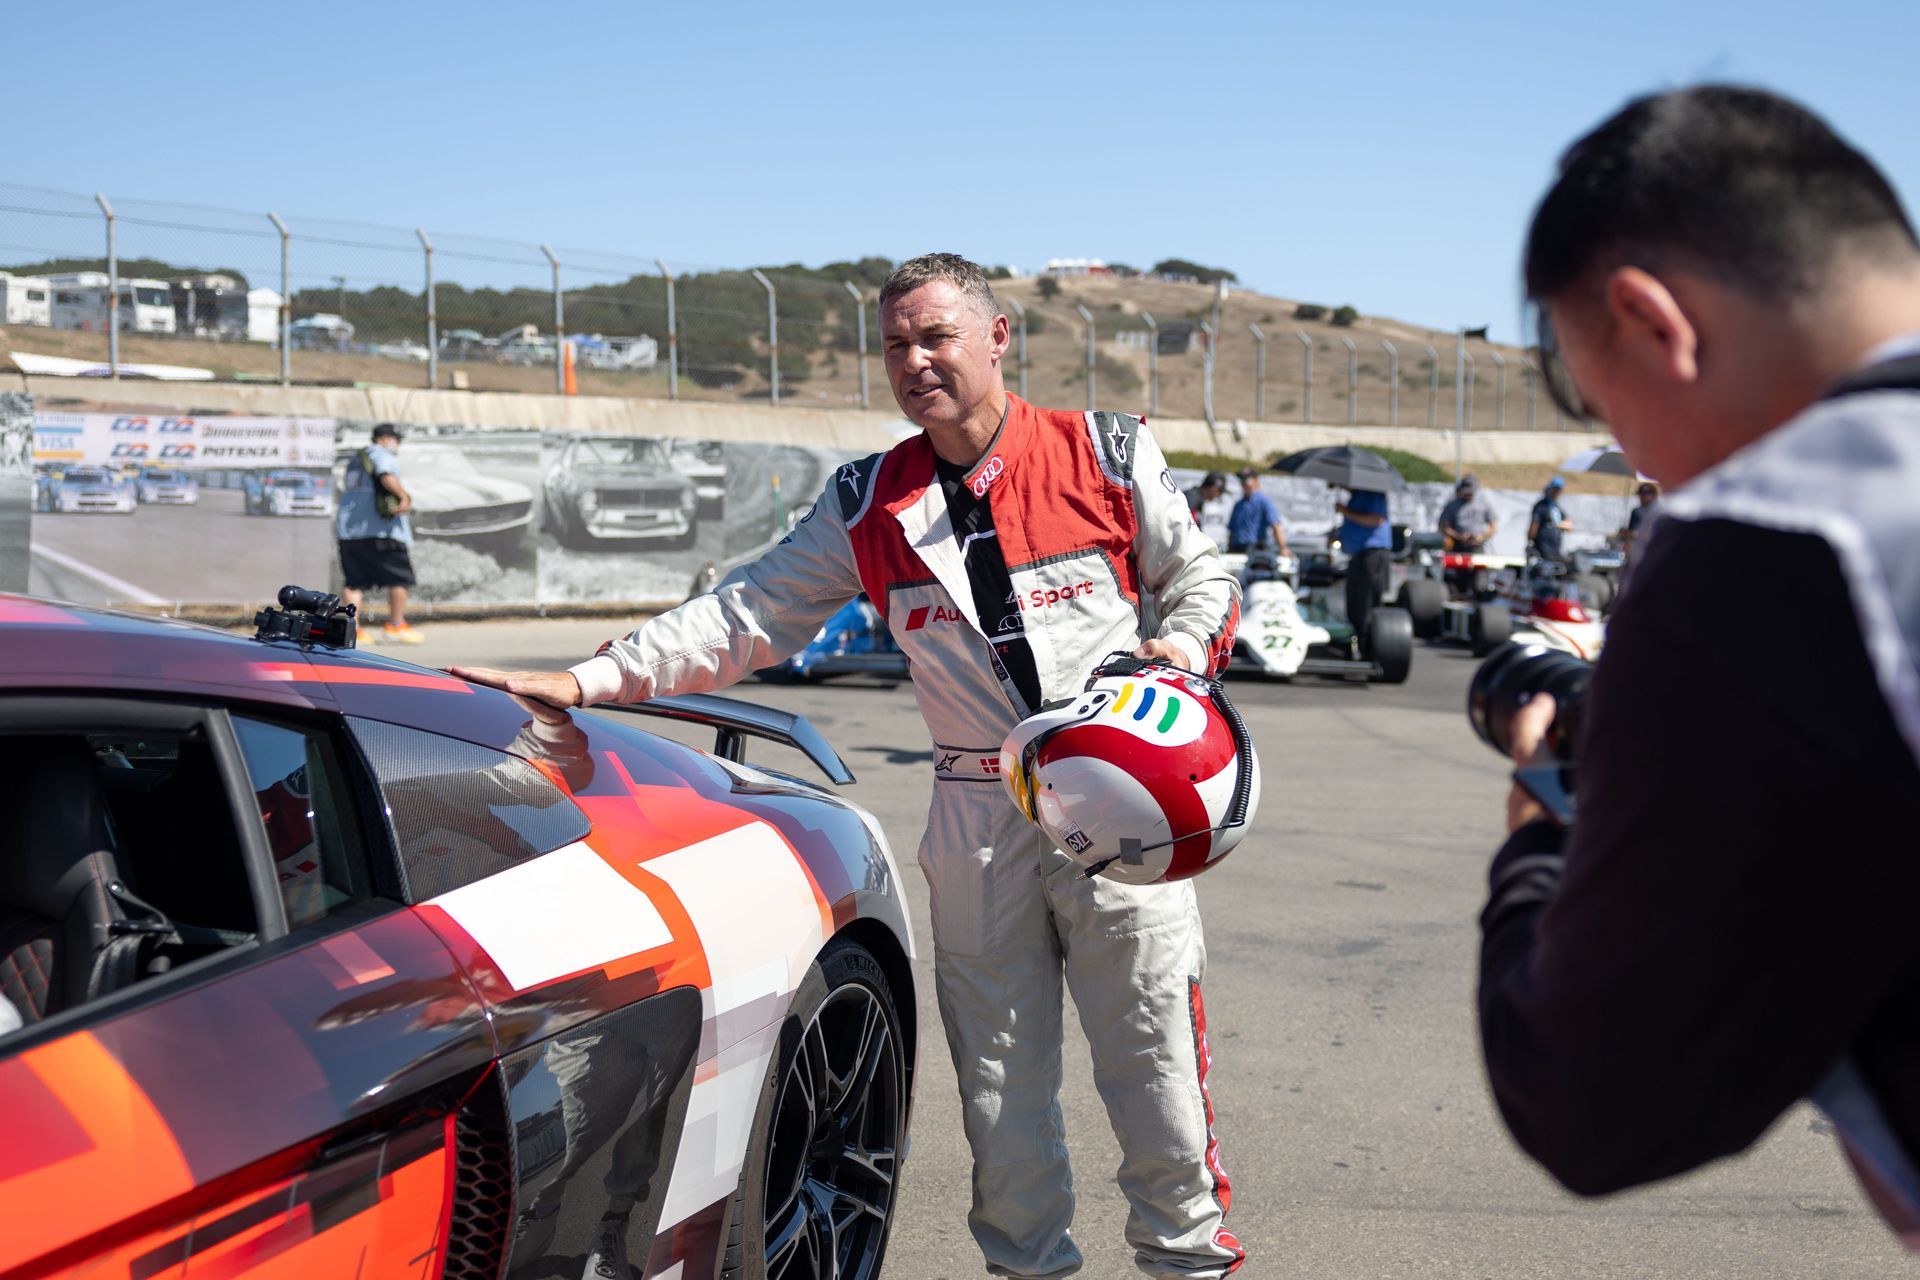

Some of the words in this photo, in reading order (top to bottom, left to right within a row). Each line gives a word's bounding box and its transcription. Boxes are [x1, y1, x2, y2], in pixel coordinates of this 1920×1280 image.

[203, 446, 280, 457] POTENZA
[1030, 580, 1094, 609] Sport
[1263, 634, 1293, 650] 27
